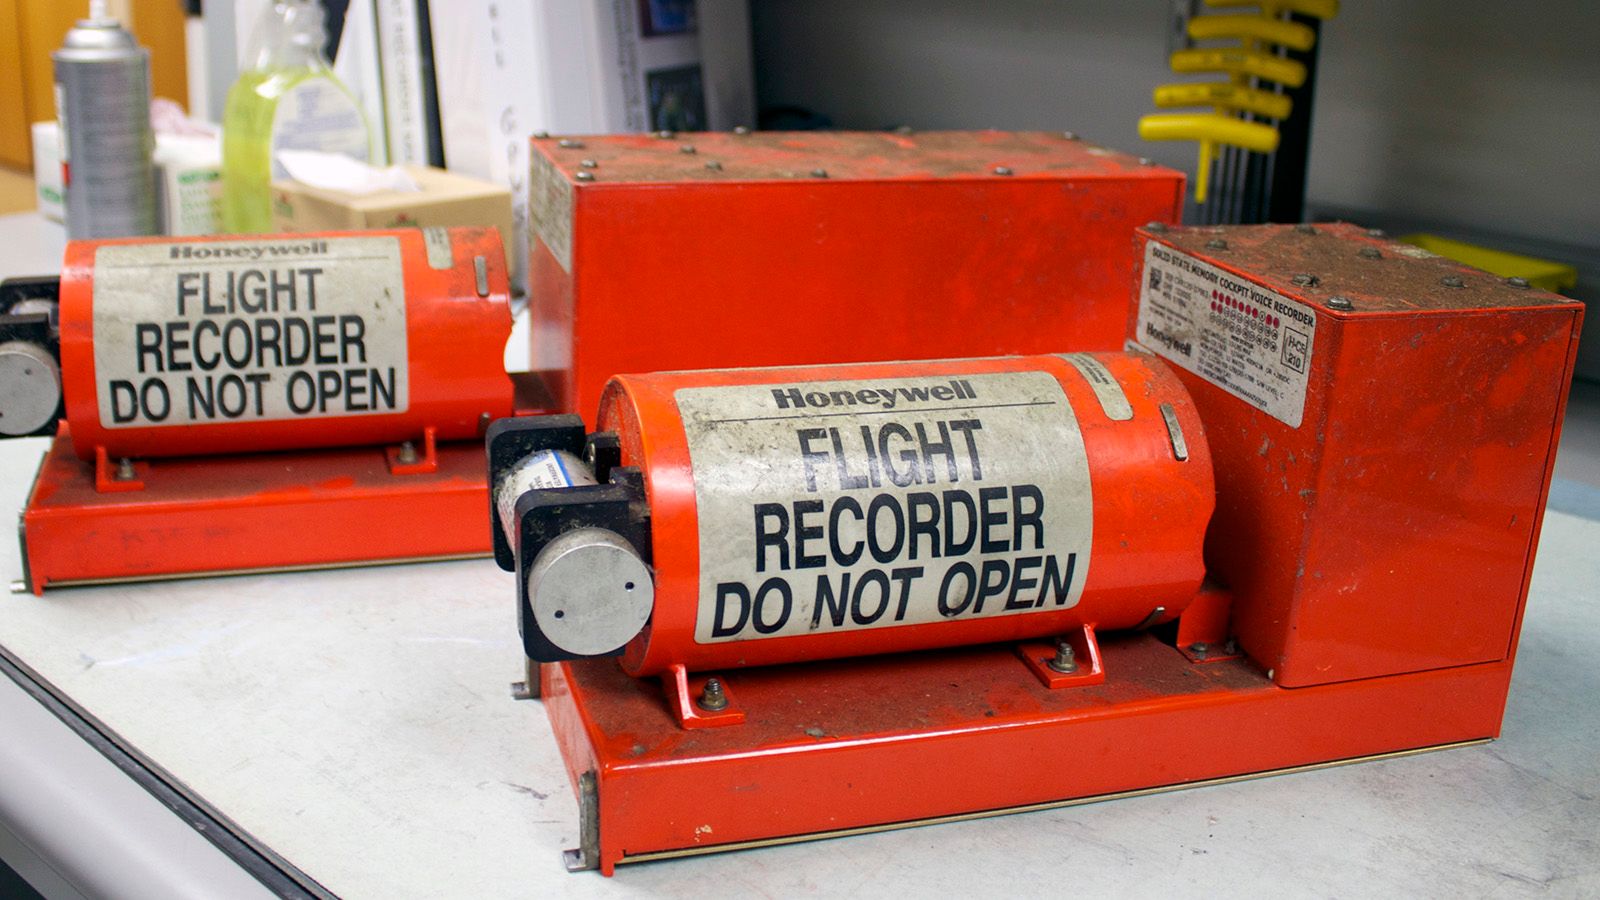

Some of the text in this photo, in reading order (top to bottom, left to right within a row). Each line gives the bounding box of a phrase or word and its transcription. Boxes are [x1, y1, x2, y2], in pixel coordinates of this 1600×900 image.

[171, 242, 327, 260] Honeywell
[178, 268, 322, 316] FLIGHT
[1153, 248, 1313, 327] SOLID STATE MEMORY COCKPIT VOICE RECORDER
[136, 314, 367, 373] RECORDER
[1147, 322, 1191, 357] Honeywell
[109, 367, 397, 424] DO NOT OPEN
[772, 380, 976, 408] Honeywell
[797, 419, 982, 492] FLIGHT
[754, 485, 1044, 572] RECORDER
[711, 553, 1075, 638] DO NOT OPEN
